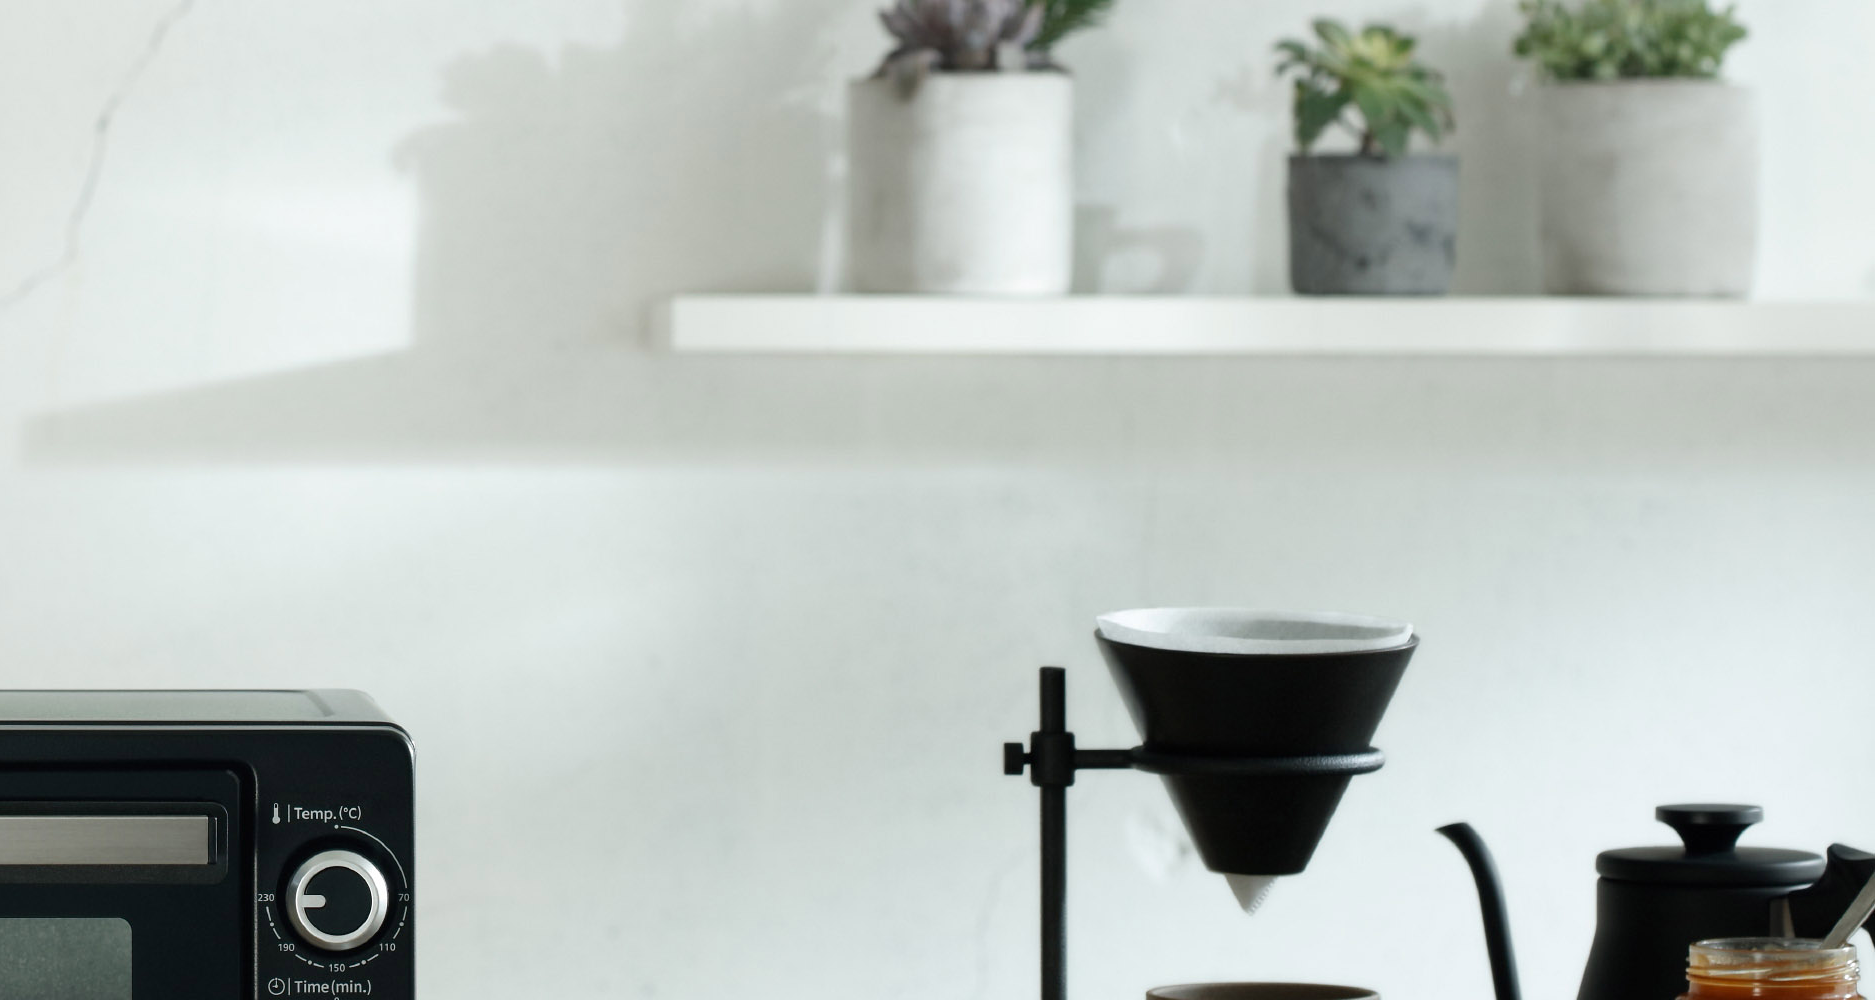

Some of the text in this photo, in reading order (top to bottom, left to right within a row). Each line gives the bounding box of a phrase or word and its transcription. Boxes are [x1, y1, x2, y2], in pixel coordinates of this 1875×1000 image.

[257, 893, 275, 902] 230
[398, 893, 410, 902] 70
[277, 942, 296, 952] 190
[379, 942, 396, 952] 110
[328, 963, 346, 973] 150
